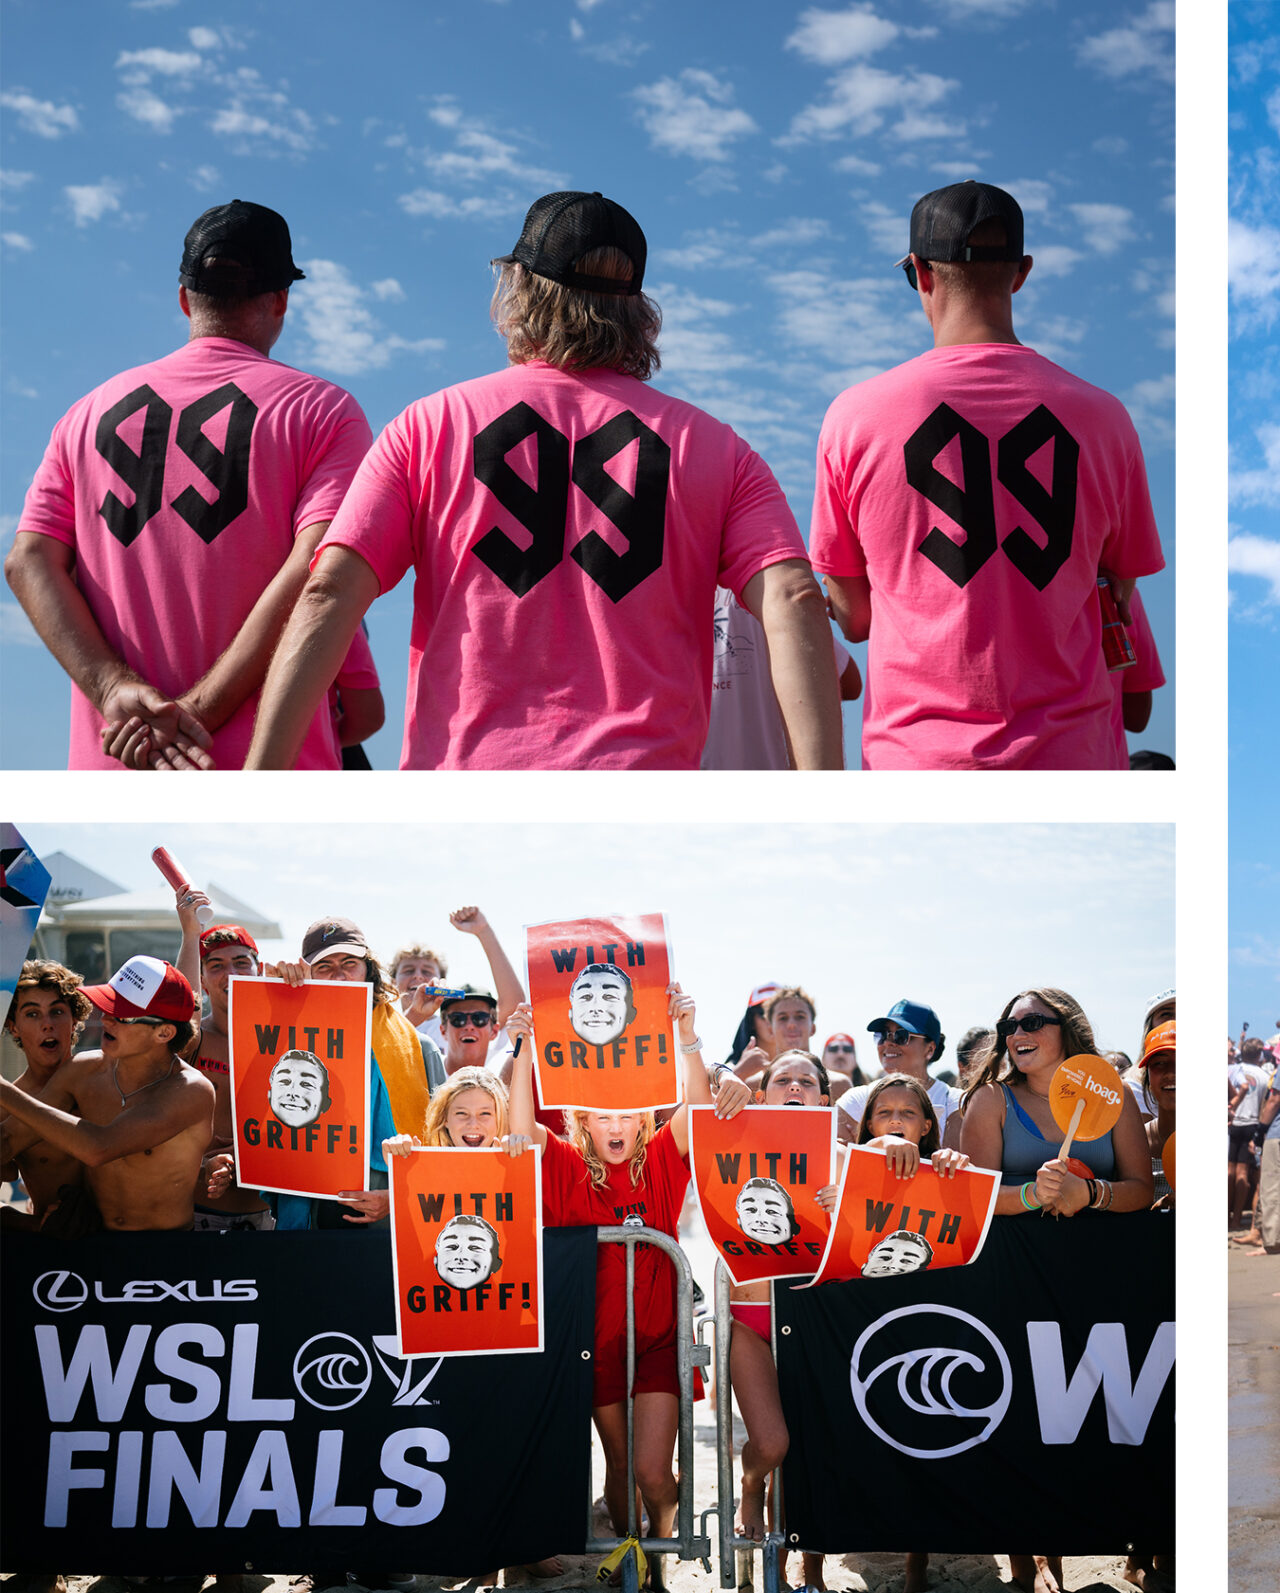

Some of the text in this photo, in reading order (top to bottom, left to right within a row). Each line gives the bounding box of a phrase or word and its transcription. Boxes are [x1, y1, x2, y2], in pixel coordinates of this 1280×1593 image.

[95, 381, 258, 547] 99
[471, 400, 670, 603] 99
[903, 401, 1080, 592] 99
[551, 941, 645, 974] WITH
[254, 1024, 344, 1060] WITH
[544, 1033, 668, 1069] GRIFF!
[1085, 1075, 1121, 1105] hoag.
[243, 1119, 358, 1154] GRIFF!
[716, 1152, 807, 1185] WITH
[417, 1191, 513, 1224] WITH
[613, 1201, 648, 1220] WITH
[865, 1198, 962, 1245] WITH
[95, 1278, 259, 1303] LEXUS
[407, 1282, 530, 1314] GRIFF!
[35, 1322, 295, 1423] WSL
[44, 1427, 451, 1529] FINALS
